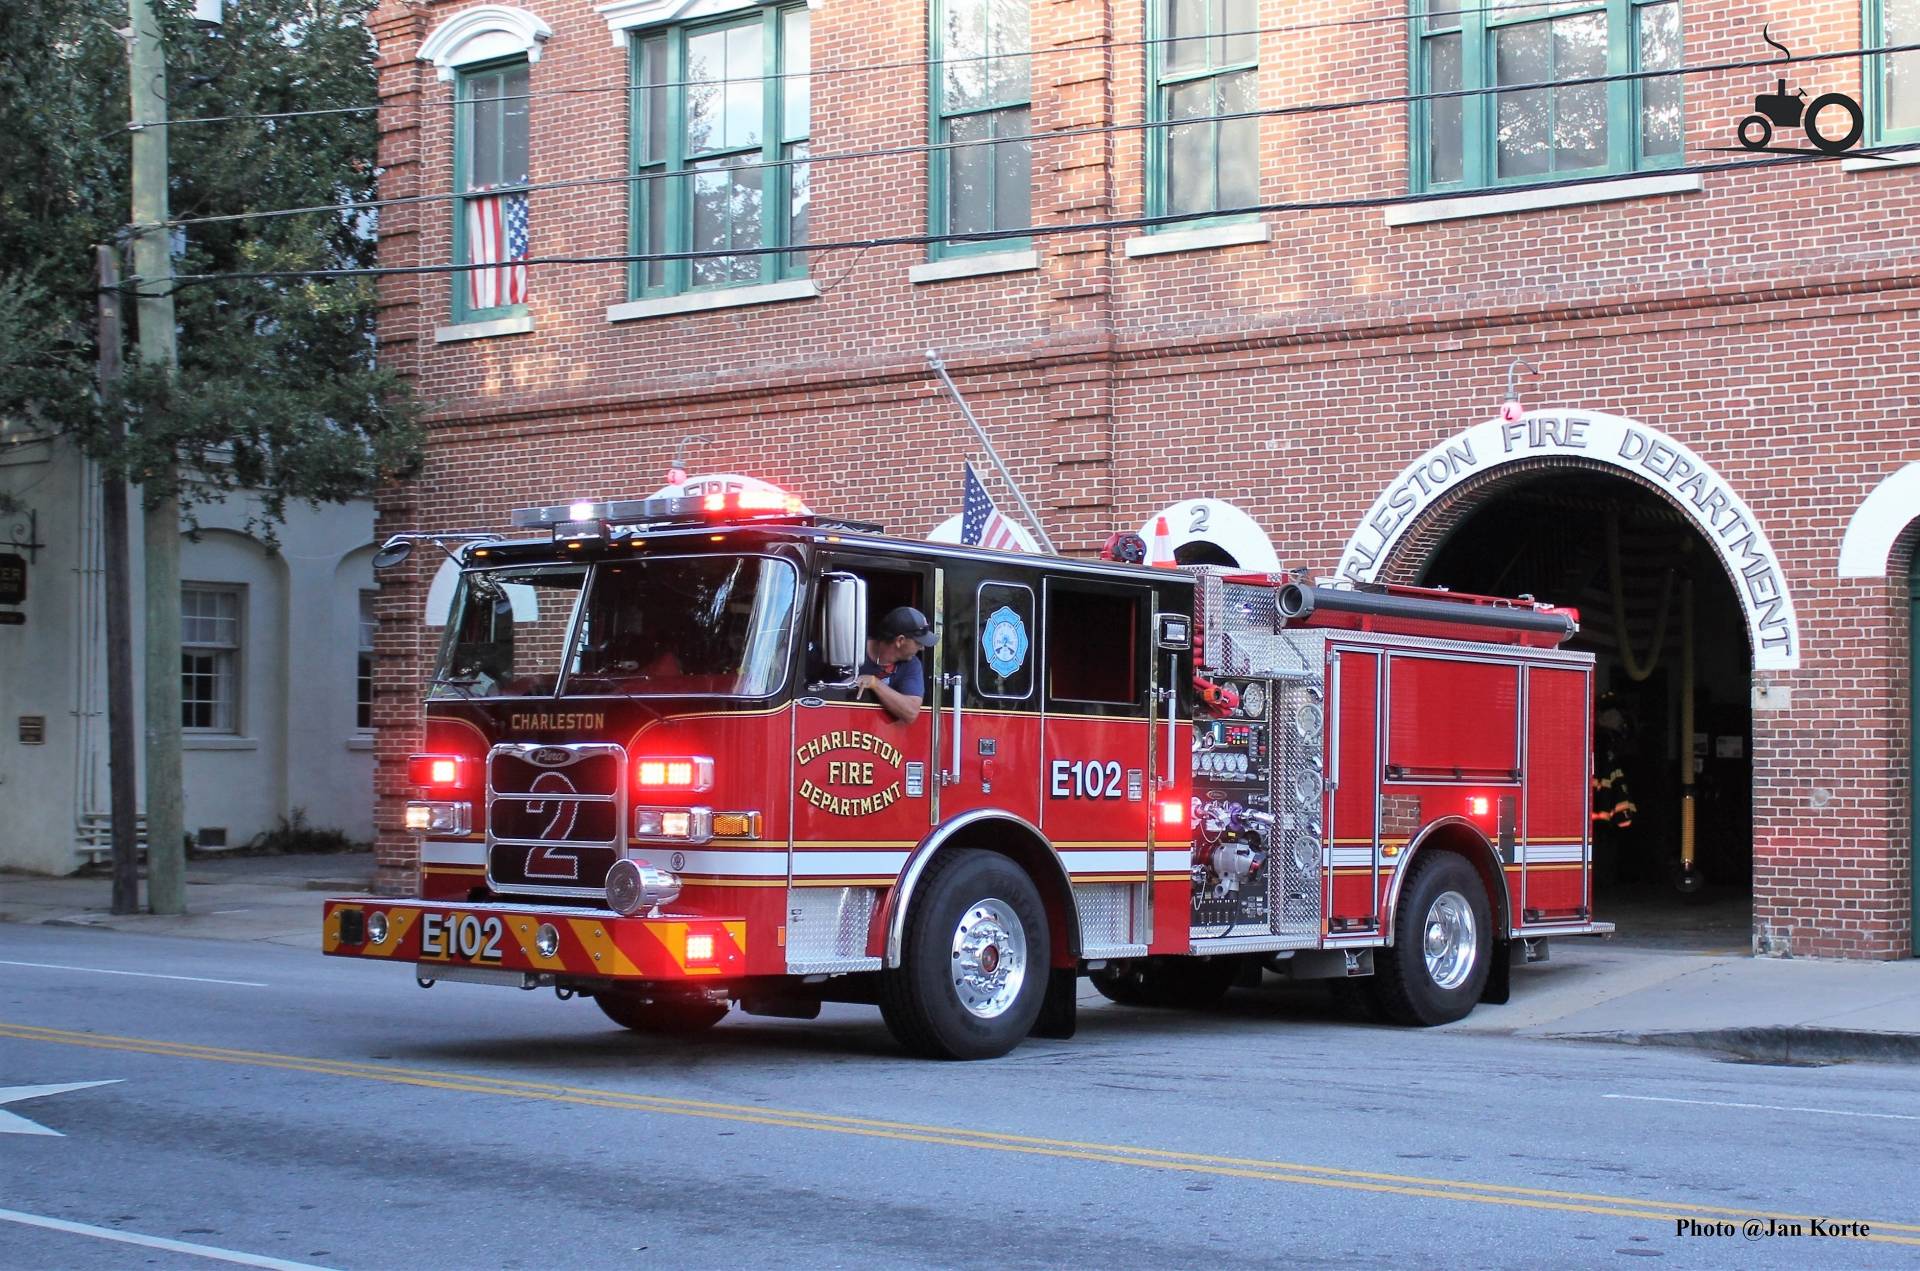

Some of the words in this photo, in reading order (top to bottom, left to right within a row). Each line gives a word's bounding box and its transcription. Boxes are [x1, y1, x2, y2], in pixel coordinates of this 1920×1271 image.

[1189, 504, 1210, 533] 2
[1343, 437, 1478, 584] RLESTON
[1501, 418, 1591, 453] FIRE
[1618, 428, 1792, 657] DEPARTMENT
[512, 713, 605, 729] CHARLESTON
[796, 730, 903, 769] CHARLESTON
[828, 761, 874, 785] FIRE
[1051, 760, 1122, 798] E102
[799, 779, 901, 816] DEPARTMENT
[524, 771, 578, 879] 2
[422, 913, 503, 958] E102
